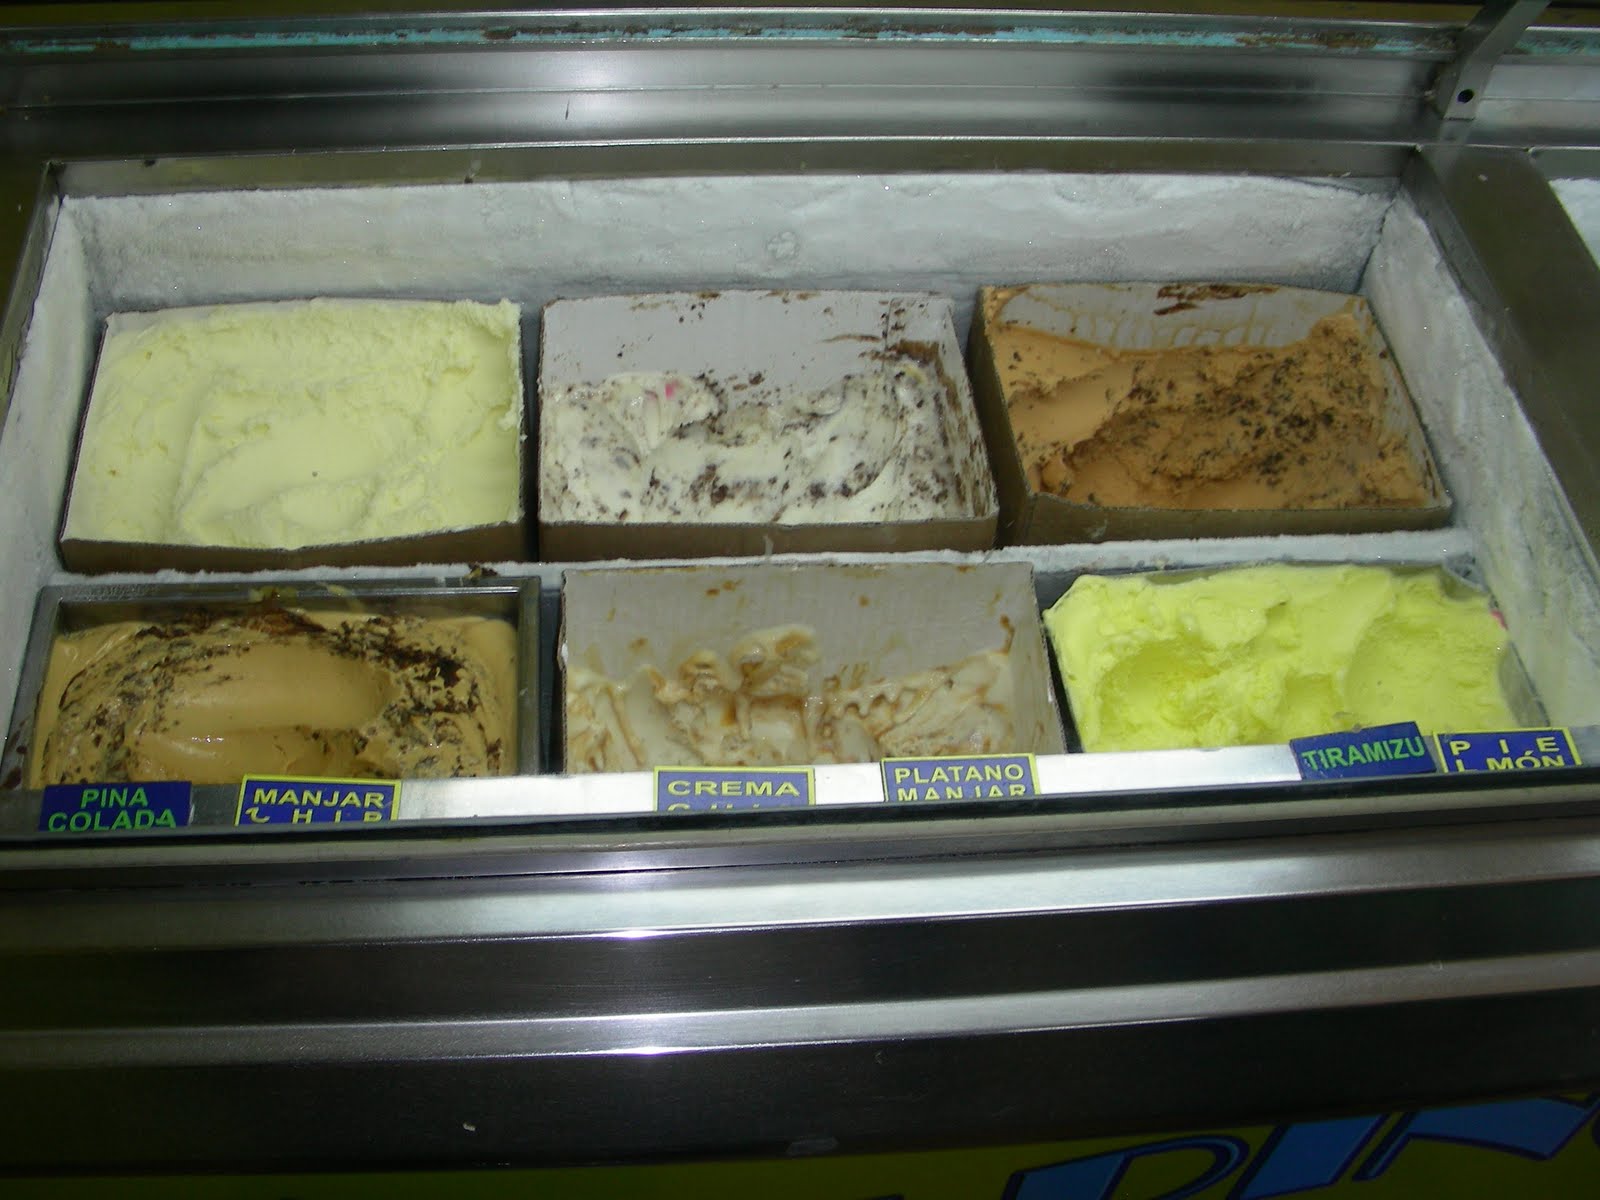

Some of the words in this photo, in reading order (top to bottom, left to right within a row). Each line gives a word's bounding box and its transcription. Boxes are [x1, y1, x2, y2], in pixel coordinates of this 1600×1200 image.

[1301, 736, 1425, 771] TIRAMIZU
[894, 763, 1024, 784] PLATANO
[80, 787, 149, 808] PINA
[253, 788, 385, 809] MANJAR
[667, 780, 800, 797] CREMA
[48, 808, 177, 832] COLADA
